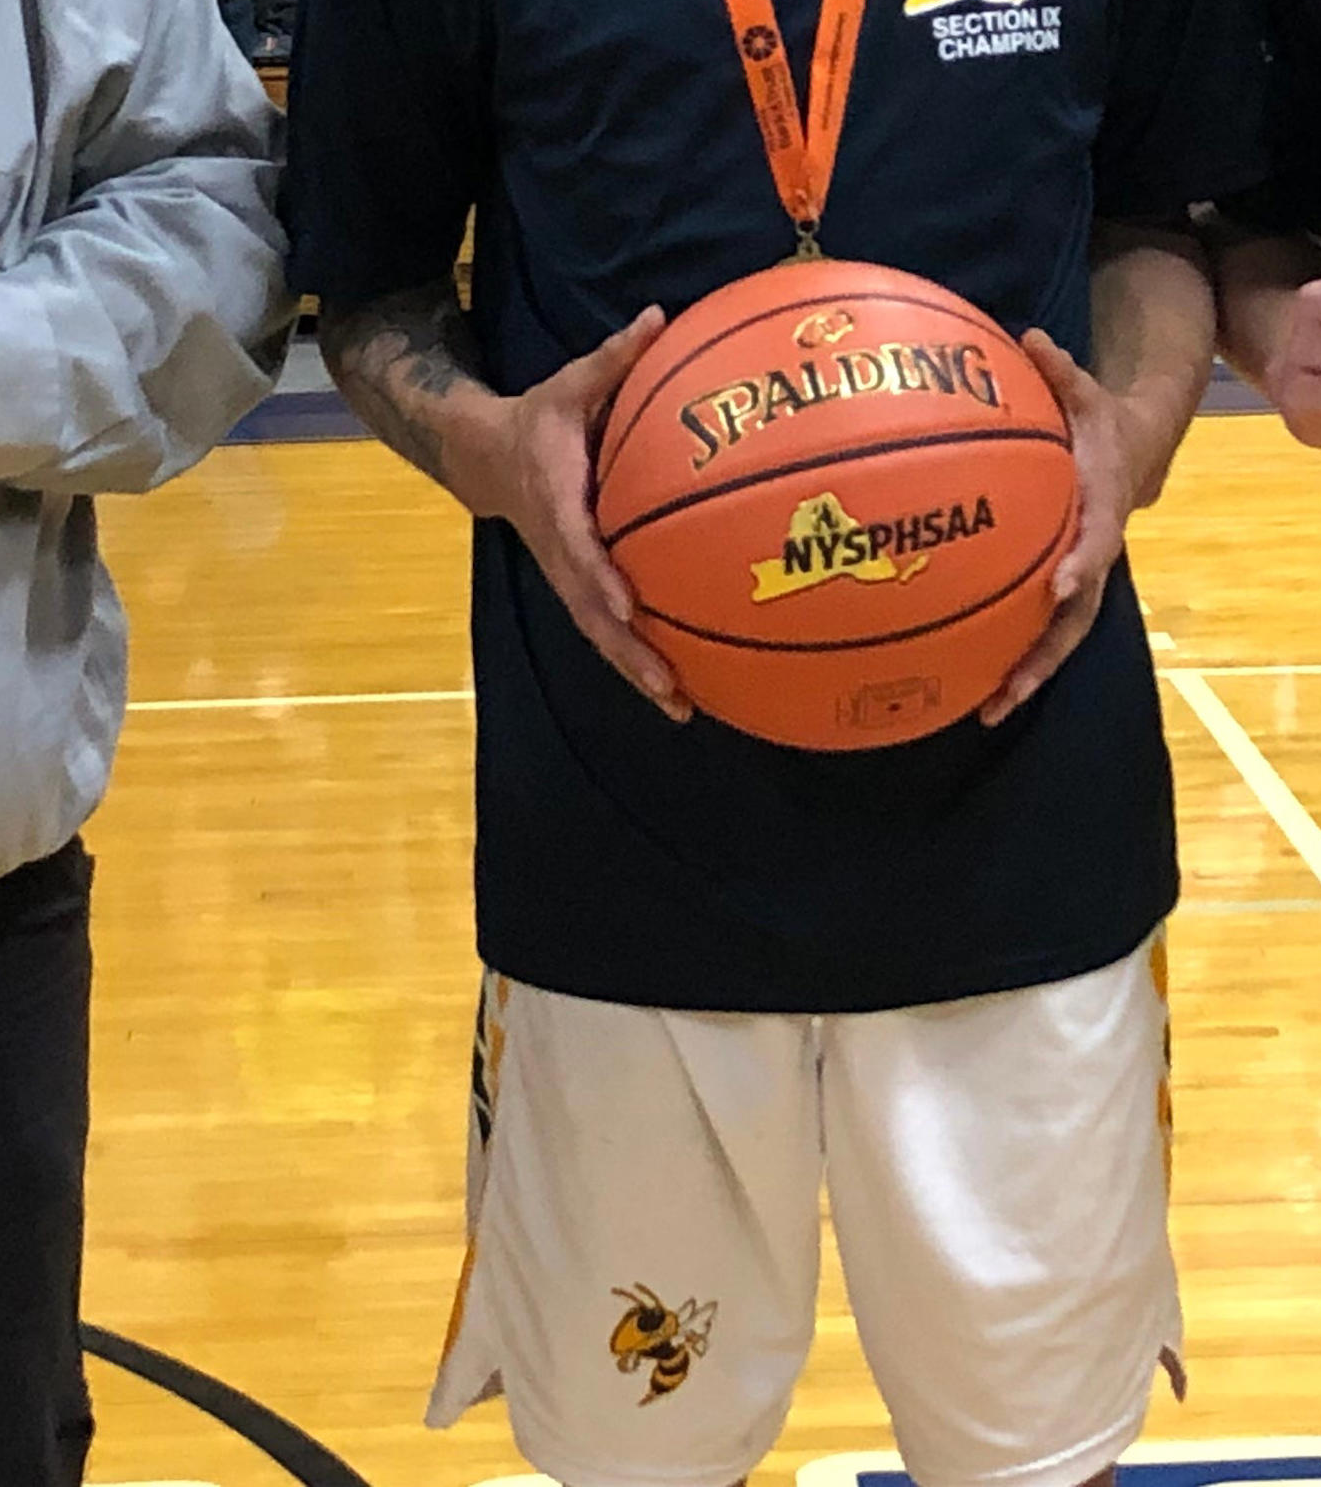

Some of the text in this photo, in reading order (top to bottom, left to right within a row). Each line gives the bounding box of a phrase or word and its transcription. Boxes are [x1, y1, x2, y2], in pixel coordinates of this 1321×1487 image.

[932, 6, 1062, 39] SECTION IX
[938, 29, 1060, 61] CHAMPION
[677, 341, 1003, 470] SPALDING
[782, 495, 996, 577] NYSPHSAA
